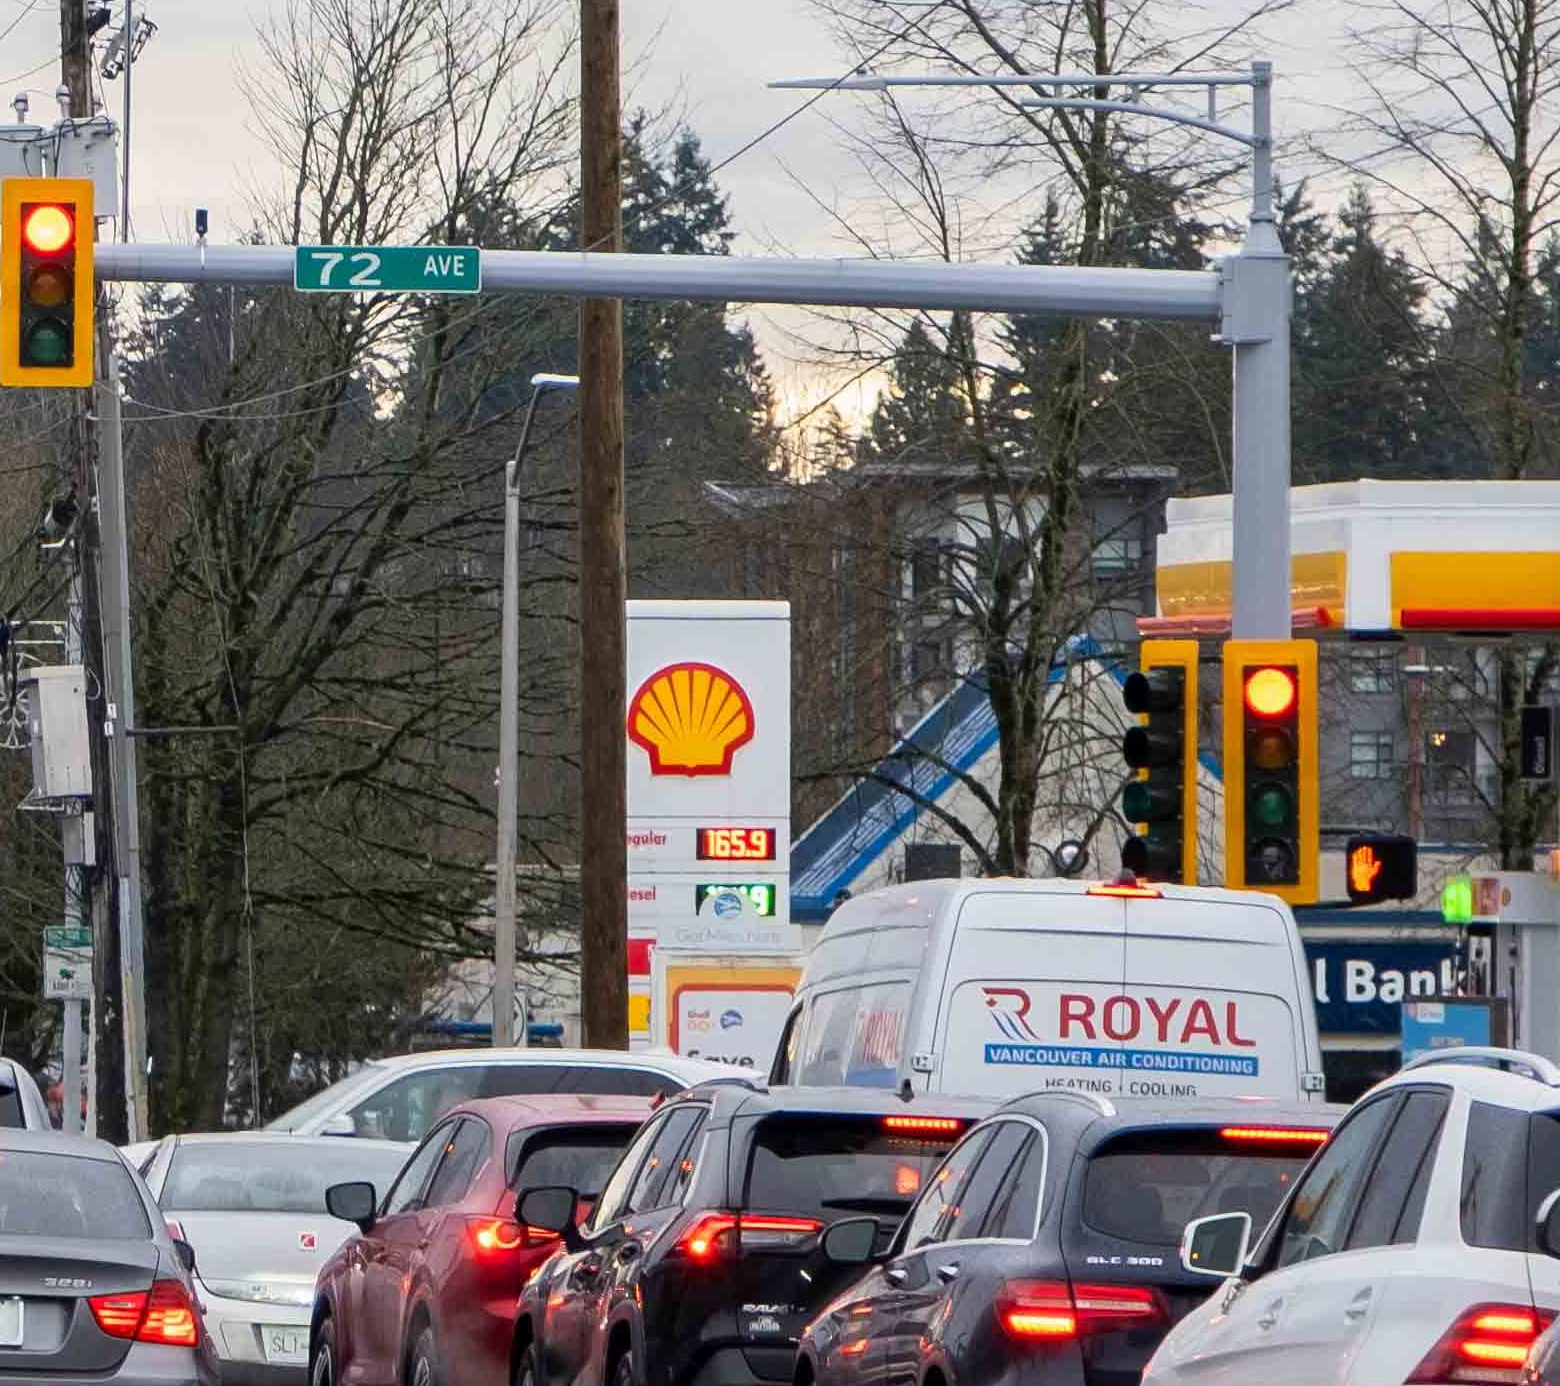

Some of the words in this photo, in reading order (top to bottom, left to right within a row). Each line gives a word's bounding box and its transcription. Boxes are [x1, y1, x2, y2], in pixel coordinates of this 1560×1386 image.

[311, 252, 382, 287] 72
[423, 255, 466, 277] AVE
[706, 829, 769, 858] 165.9
[1345, 958, 1467, 1003] Bank
[1058, 994, 1257, 1047] ROYAL
[989, 1047, 1093, 1066] VANCOUVER
[1097, 1053, 1127, 1067] AIR
[1131, 1054, 1255, 1075] CONDITIONING
[1130, 1081, 1197, 1097] COOLING
[44, 1277, 93, 1288] 328i
